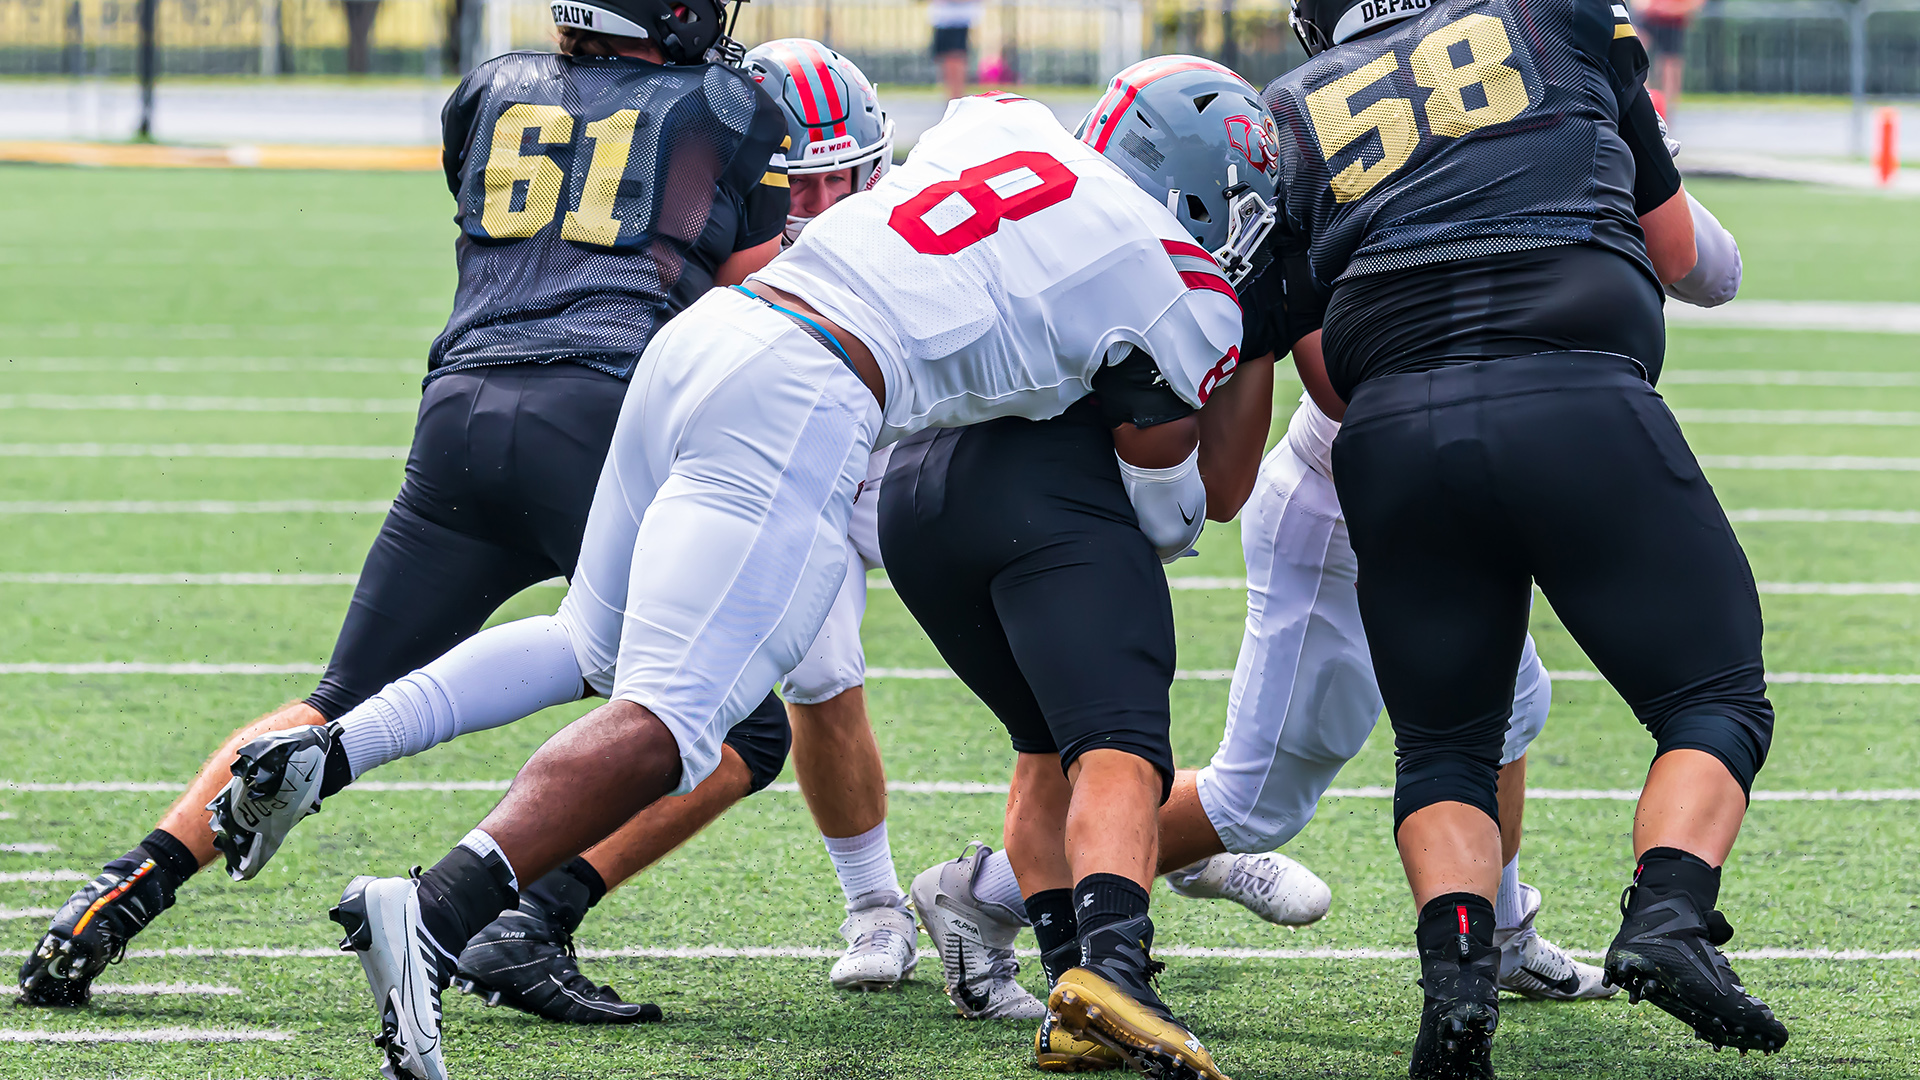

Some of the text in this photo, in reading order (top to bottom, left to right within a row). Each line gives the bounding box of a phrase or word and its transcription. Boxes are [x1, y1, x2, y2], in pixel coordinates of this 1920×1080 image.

[551, 5, 593, 27] EPAUW
[1305, 14, 1531, 204] 58
[480, 103, 640, 247] 61
[812, 140, 852, 155] WE WORK
[887, 150, 1079, 256] 8
[1197, 344, 1240, 405] 8
[237, 760, 307, 827] VAPOR
[950, 919, 979, 936] ALPHA
